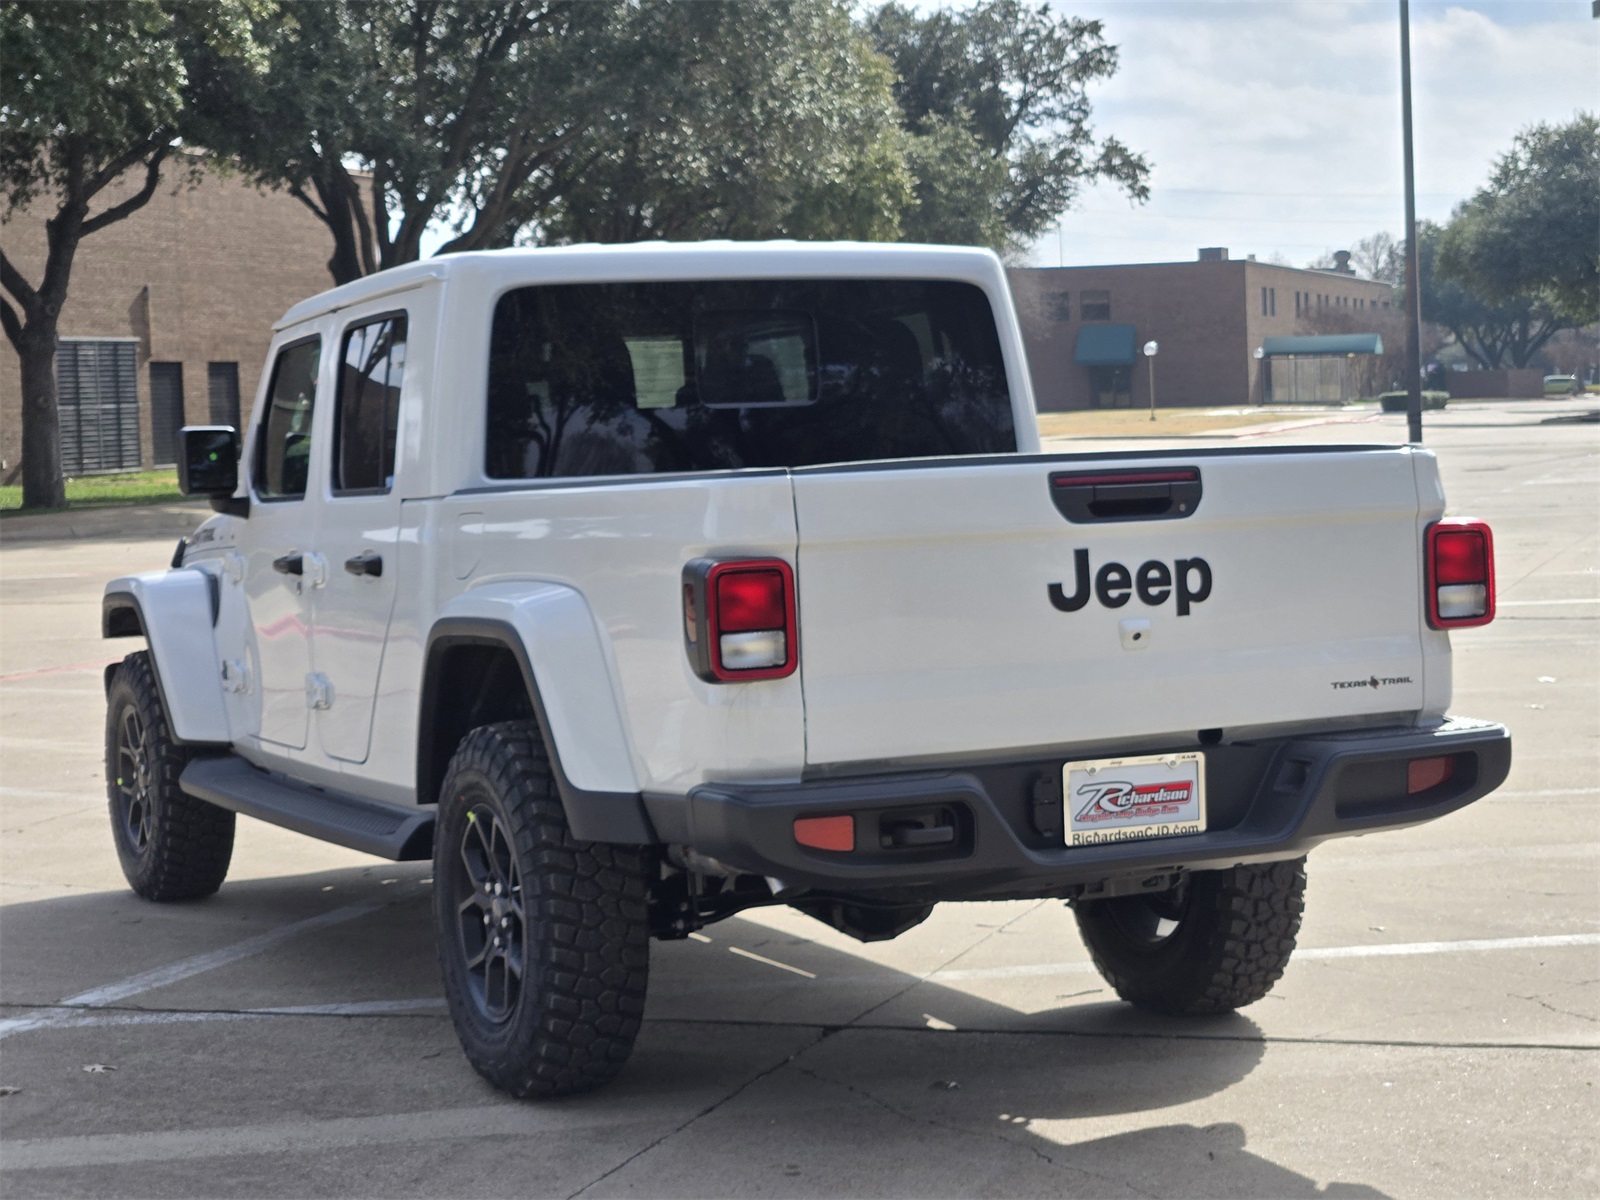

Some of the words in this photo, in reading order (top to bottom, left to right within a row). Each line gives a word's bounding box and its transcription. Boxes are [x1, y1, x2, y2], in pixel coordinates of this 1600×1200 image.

[1047, 548, 1212, 616] Jeep
[1330, 680, 1367, 690] TEXAS
[1380, 676, 1412, 686] TRAIL
[1074, 780, 1189, 822] Richardson
[1072, 823, 1199, 846] RichardsonCJD.com
